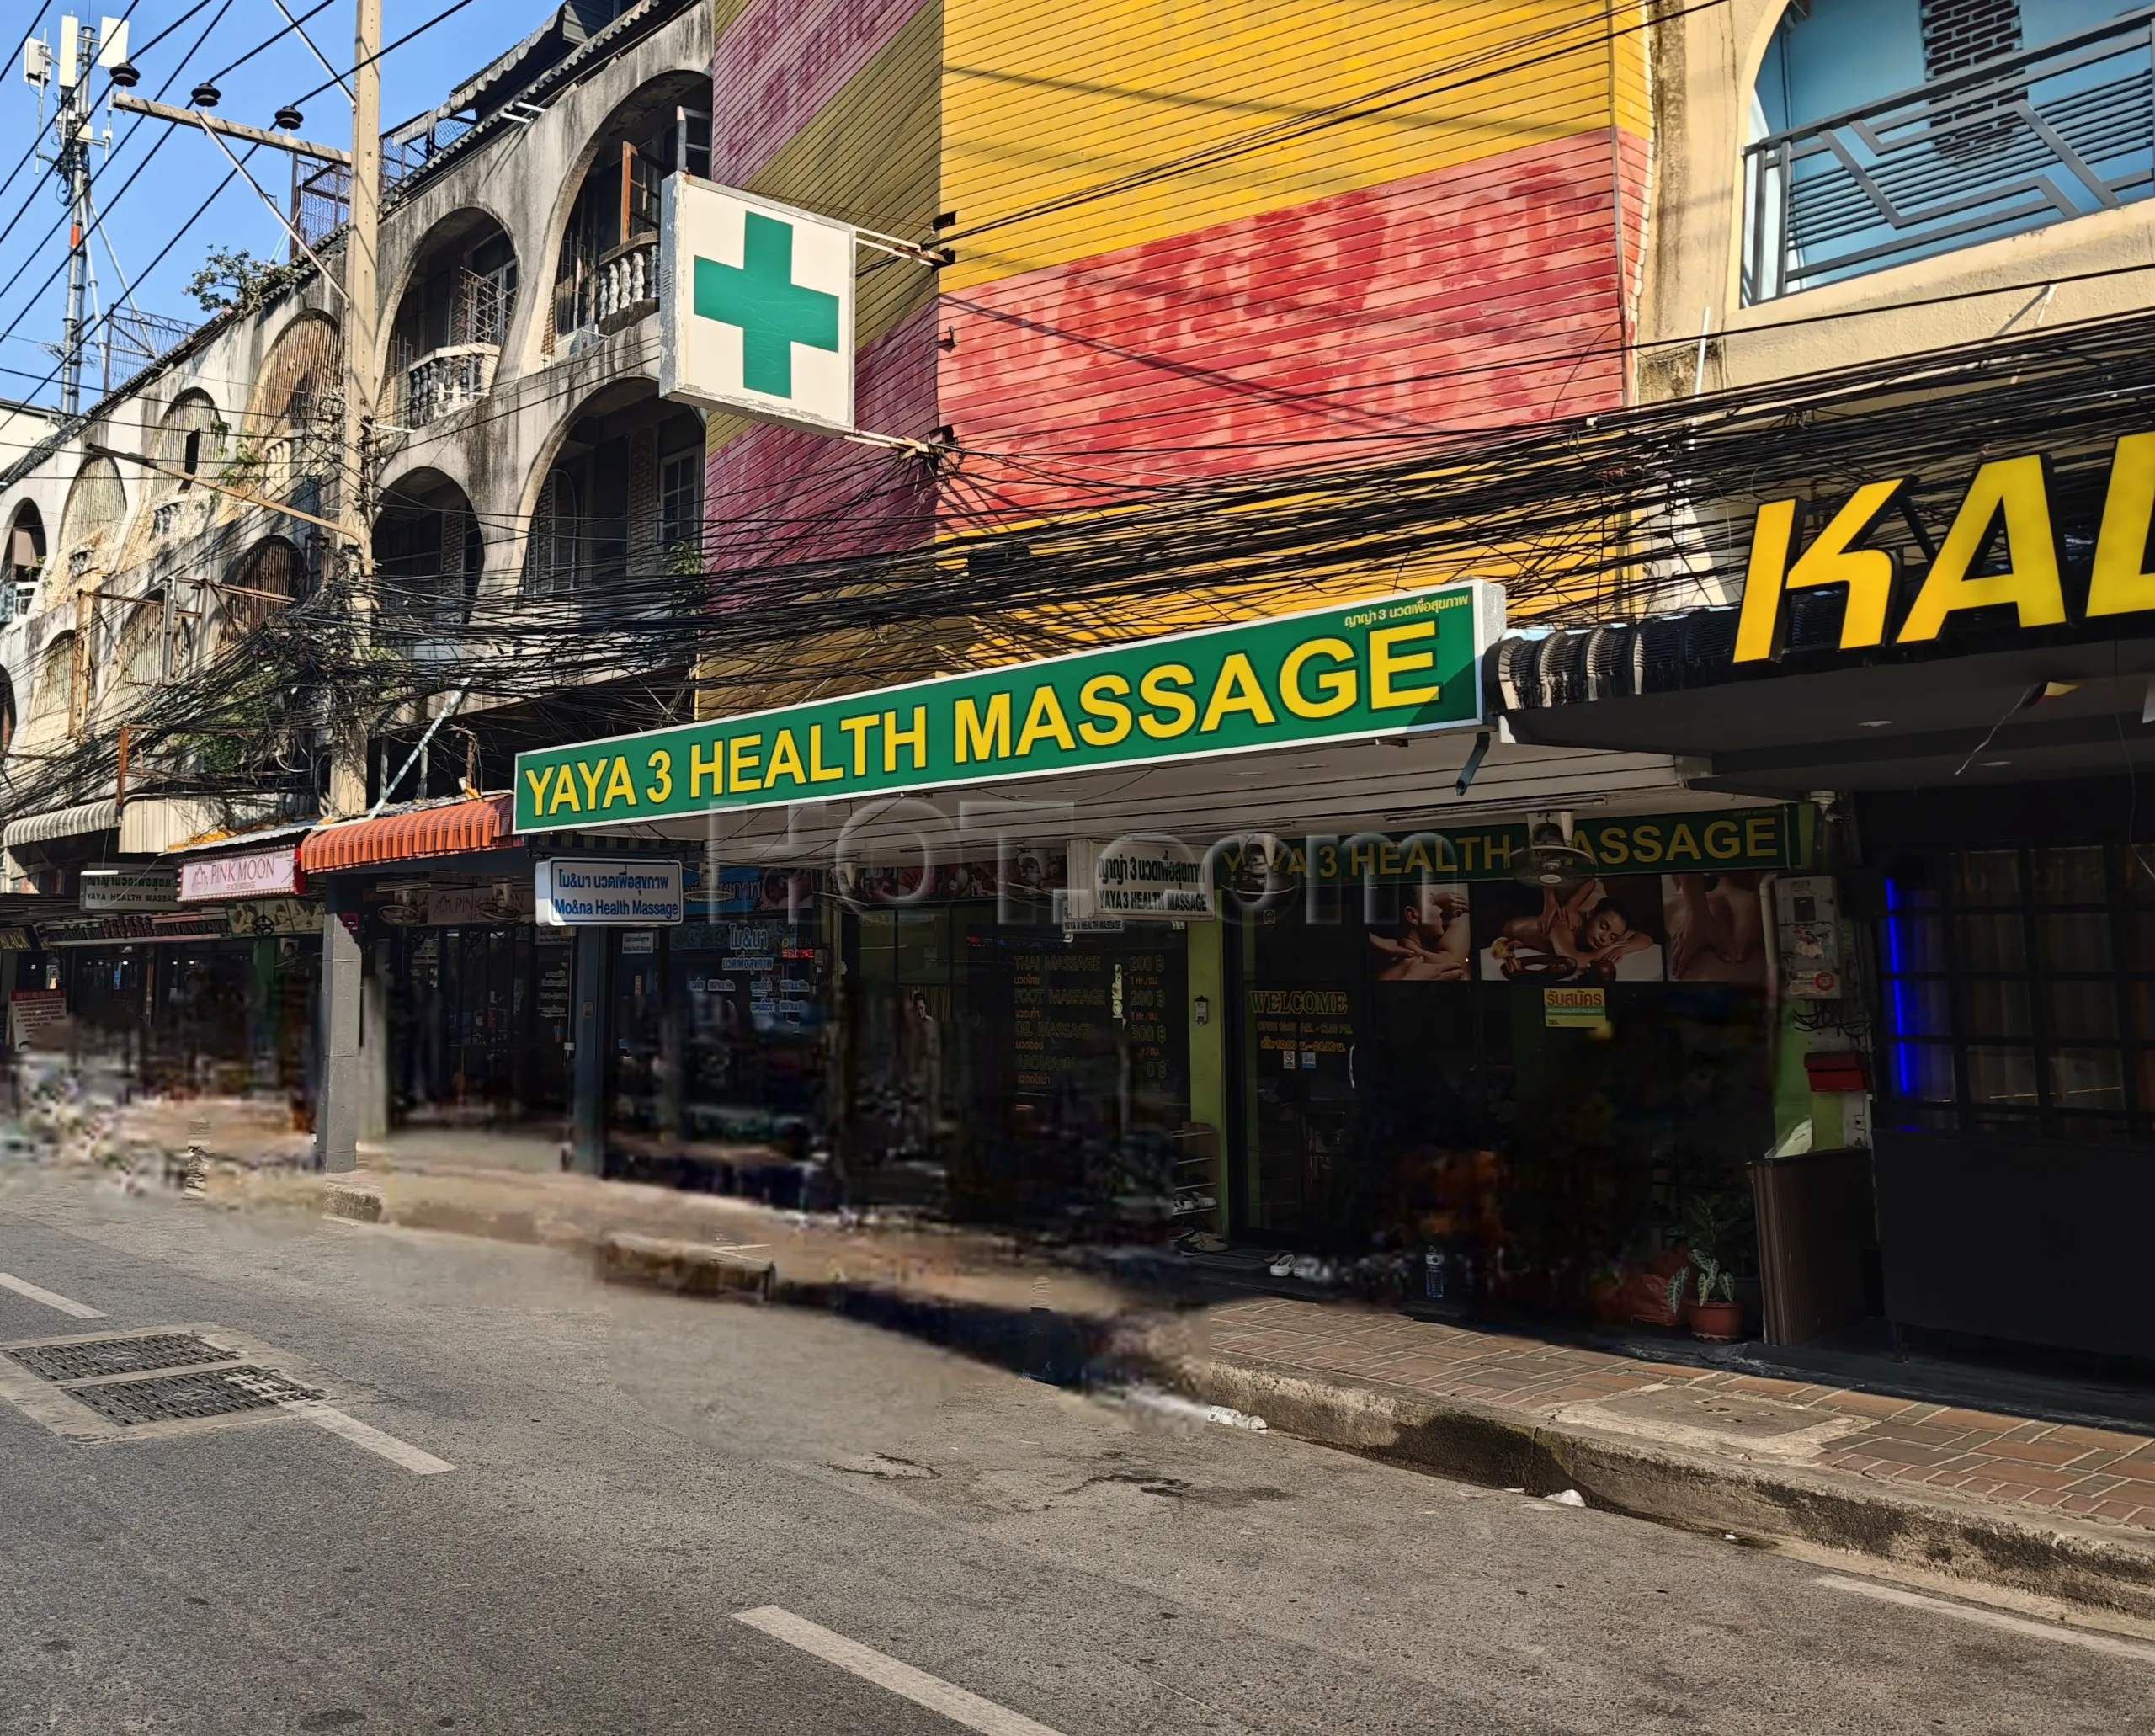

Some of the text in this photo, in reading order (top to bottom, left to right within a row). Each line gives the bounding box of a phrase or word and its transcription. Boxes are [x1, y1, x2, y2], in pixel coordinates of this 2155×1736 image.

[1344, 595, 1469, 628] ญาญ่า 3 นวดเพื่อสุขภาพ
[525, 621, 1439, 816] YAYA 3 HEALTH MASSAGE
[1319, 845, 1338, 878] 3
[1351, 833, 1511, 876] HEALTH
[1572, 817, 1775, 866] ASSAGE
[211, 856, 275, 885] PINK MOON
[1130, 856, 1137, 881] 3
[558, 865, 669, 896] โม&นา นวดเพื่อสุขภาพ
[110, 894, 141, 903] HEALTH
[554, 898, 678, 919] Mo&na Health Massage
[1098, 890, 1207, 912] YAYA 3 HEALTH MASSAGE
[1014, 955, 1101, 972] THAI MASSAGE
[1129, 955, 1152, 972] 200
[1014, 988, 1106, 1005] FOOT MASSAGE
[1130, 990, 1153, 1006] 200
[1248, 990, 1349, 1015] WELCOME
[1546, 990, 1602, 1006] รับสมัคร
